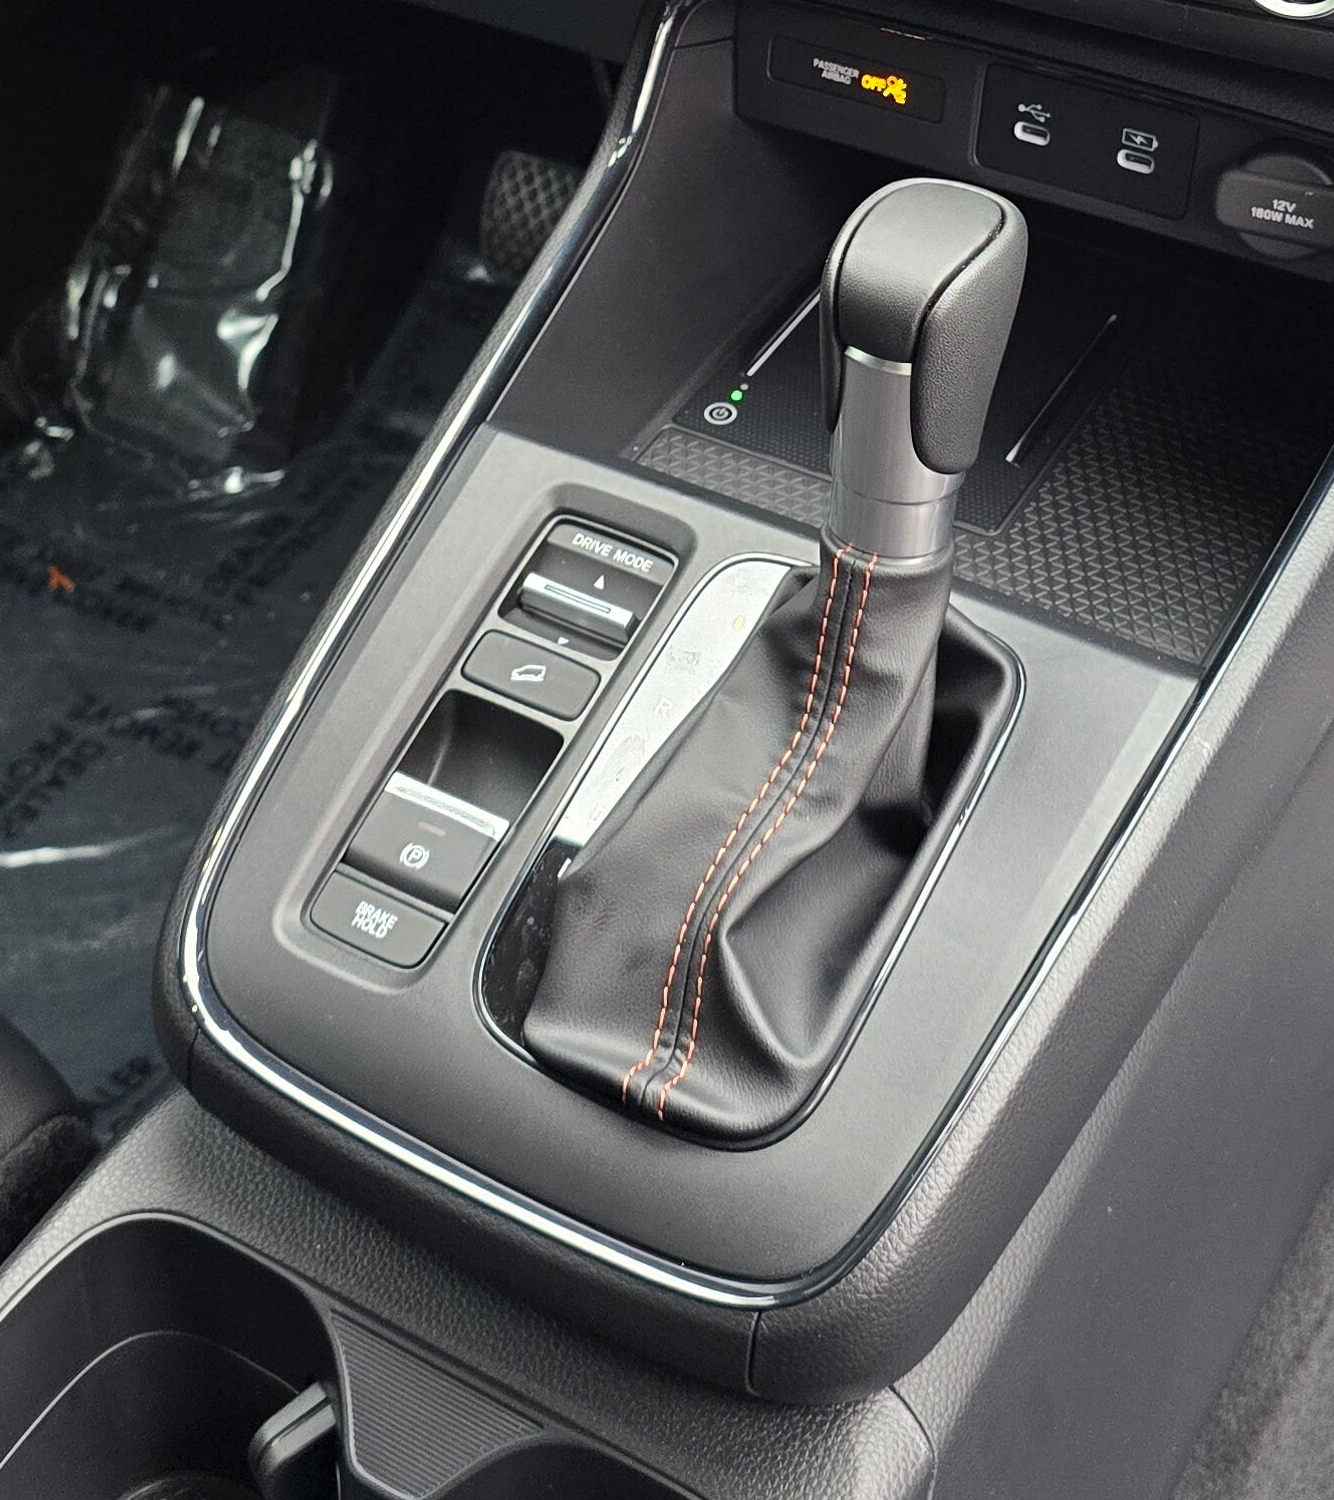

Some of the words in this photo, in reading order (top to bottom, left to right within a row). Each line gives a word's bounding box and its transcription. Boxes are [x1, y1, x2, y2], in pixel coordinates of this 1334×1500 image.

[1251, 206, 1283, 223] 180W
[1284, 213, 1314, 229] MAX
[1272, 199, 1297, 213] 12V
[571, 532, 611, 558] DRIVE
[612, 548, 653, 573] MODE
[351, 913, 388, 940] HOLD
[354, 901, 398, 930] BRAKE
